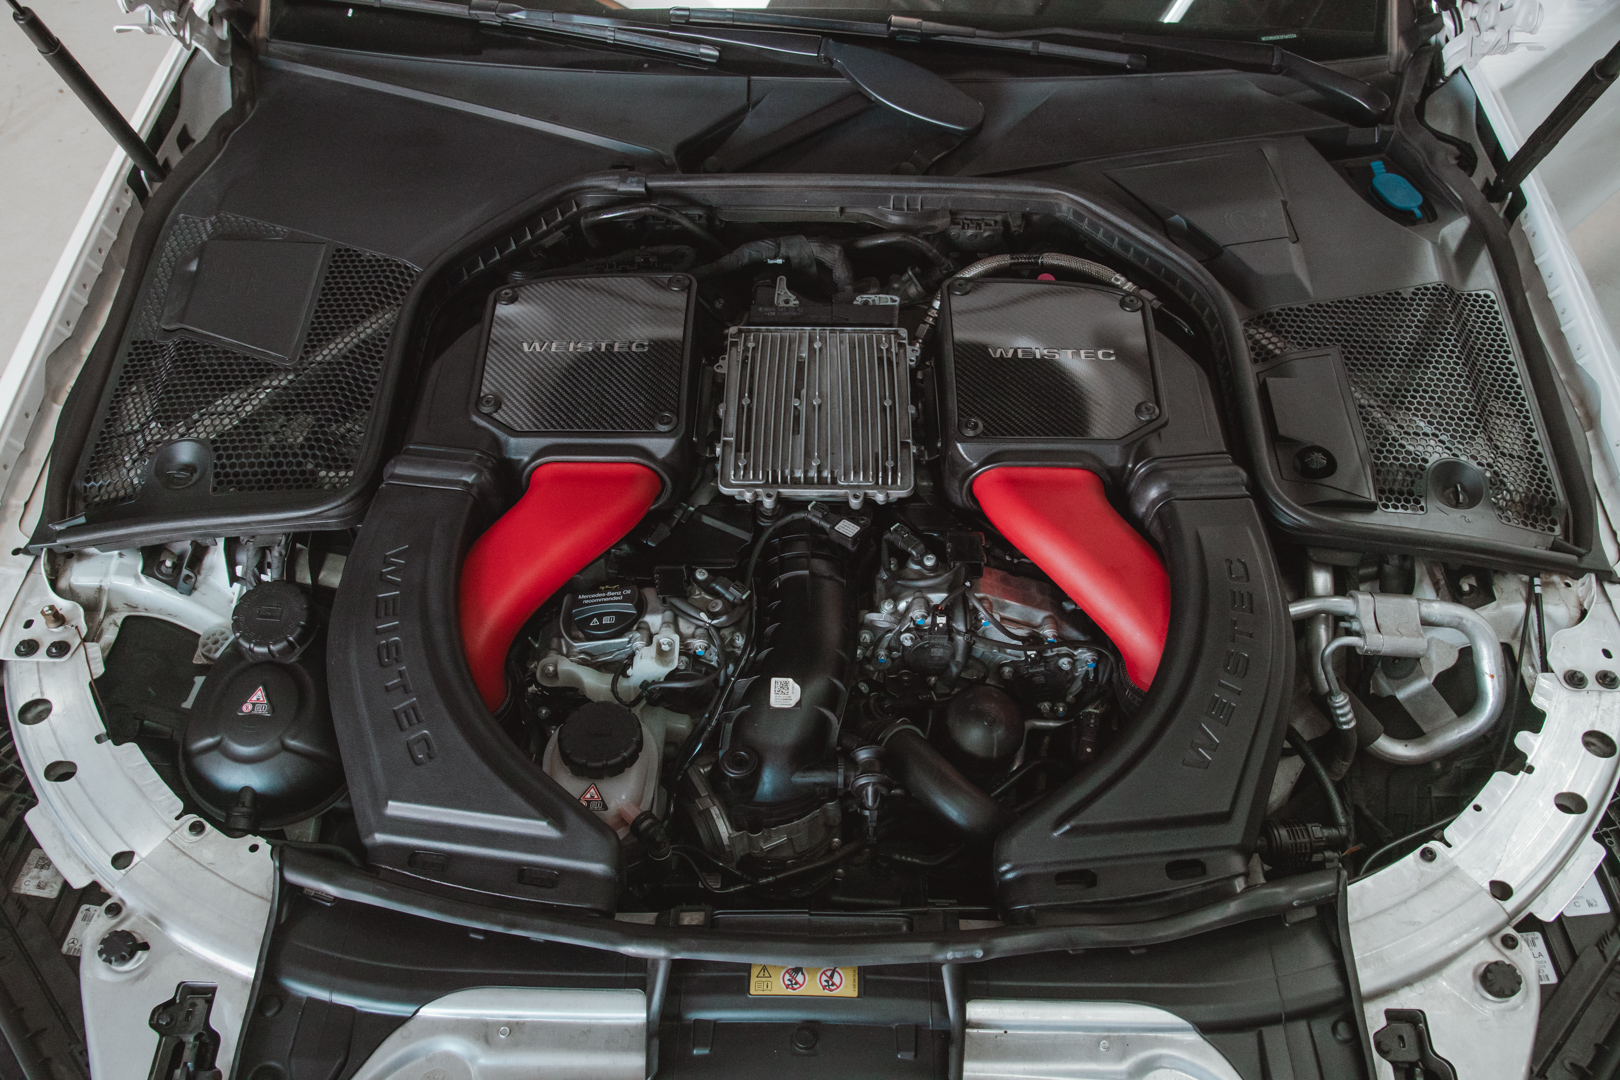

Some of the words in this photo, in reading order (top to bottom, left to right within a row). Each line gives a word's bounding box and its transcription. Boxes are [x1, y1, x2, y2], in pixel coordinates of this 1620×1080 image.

[521, 340, 650, 353] WEISTEC
[986, 345, 1118, 361] WEISTEC
[578, 591, 622, 600] Mercedes-Benz
[582, 596, 623, 604] recommended
[374, 544, 437, 767] WEISTEC
[1181, 557, 1255, 770] WEISTEC
